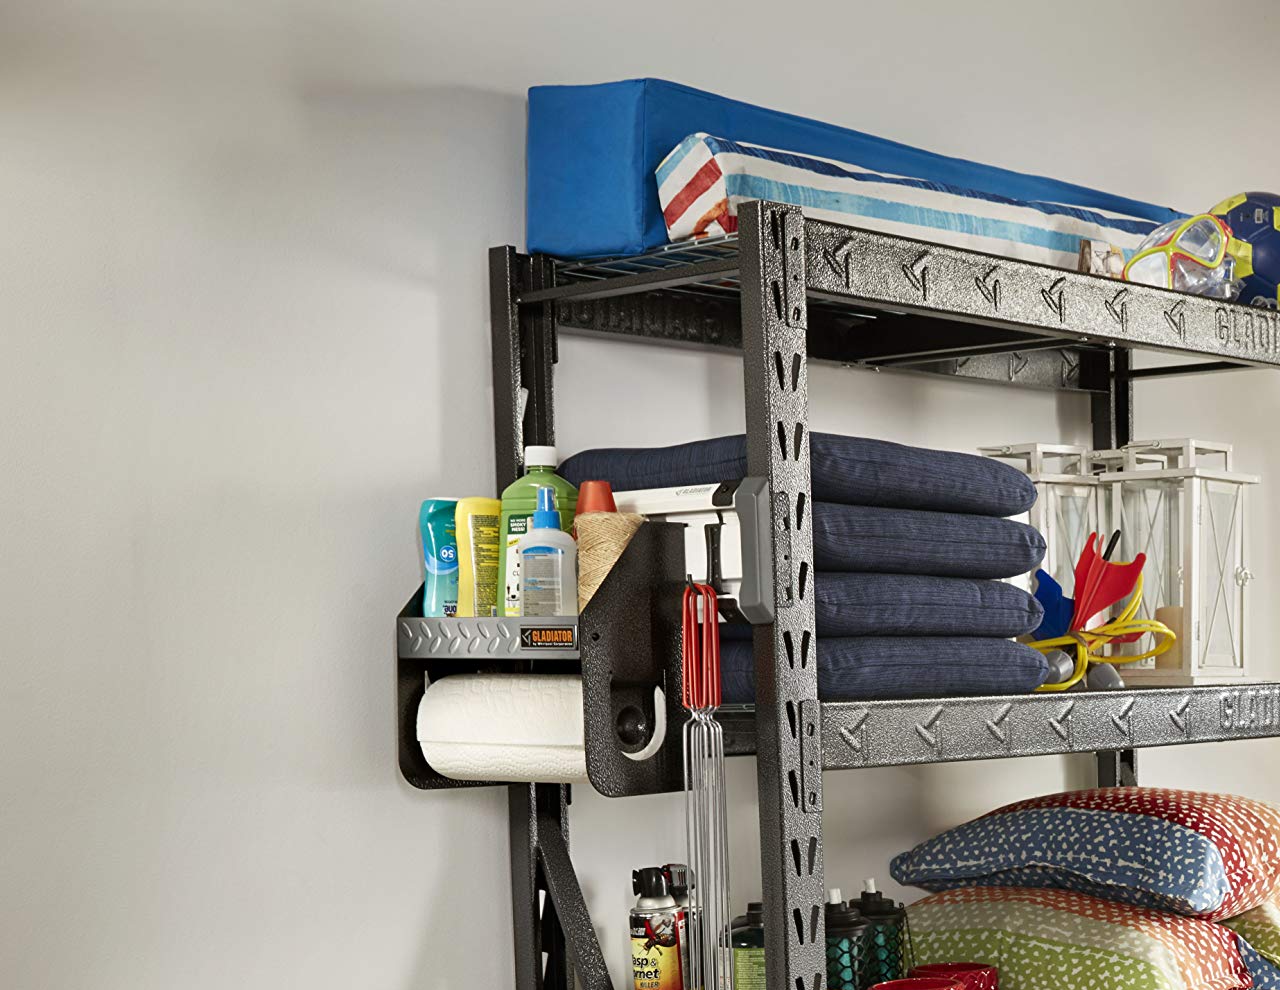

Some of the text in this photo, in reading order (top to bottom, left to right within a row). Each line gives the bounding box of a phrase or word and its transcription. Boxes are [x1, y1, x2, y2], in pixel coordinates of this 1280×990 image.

[441, 549, 454, 558] 50
[532, 630, 573, 642] GLADIATOR
[632, 954, 649, 969] asp
[633, 969, 660, 979] rnet
